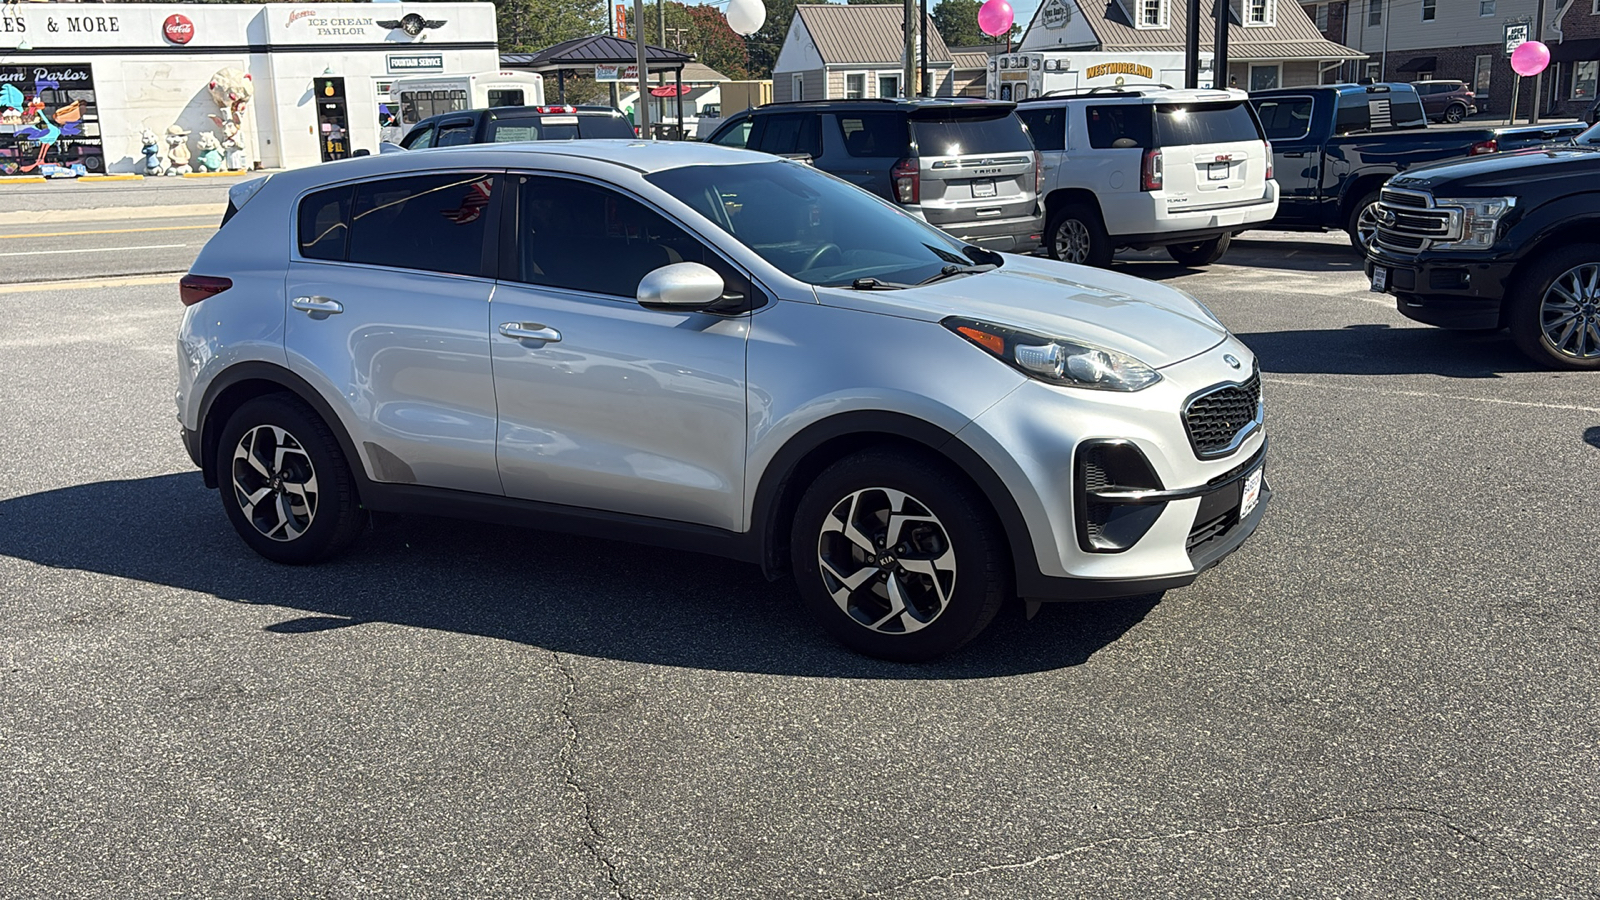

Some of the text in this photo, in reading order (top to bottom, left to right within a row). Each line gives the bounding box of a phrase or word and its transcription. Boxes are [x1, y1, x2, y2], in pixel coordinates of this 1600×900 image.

[0, 16, 120, 32] ES & MORE
[308, 18, 373, 26] ICE CREAM
[318, 27, 365, 35] PARLOR
[391, 58, 441, 67] FOUNTAIN SERVICE
[33, 68, 89, 81] Parlor
[1086, 62, 1153, 79] WESTMORELAND
[880, 555, 895, 566] KIA
